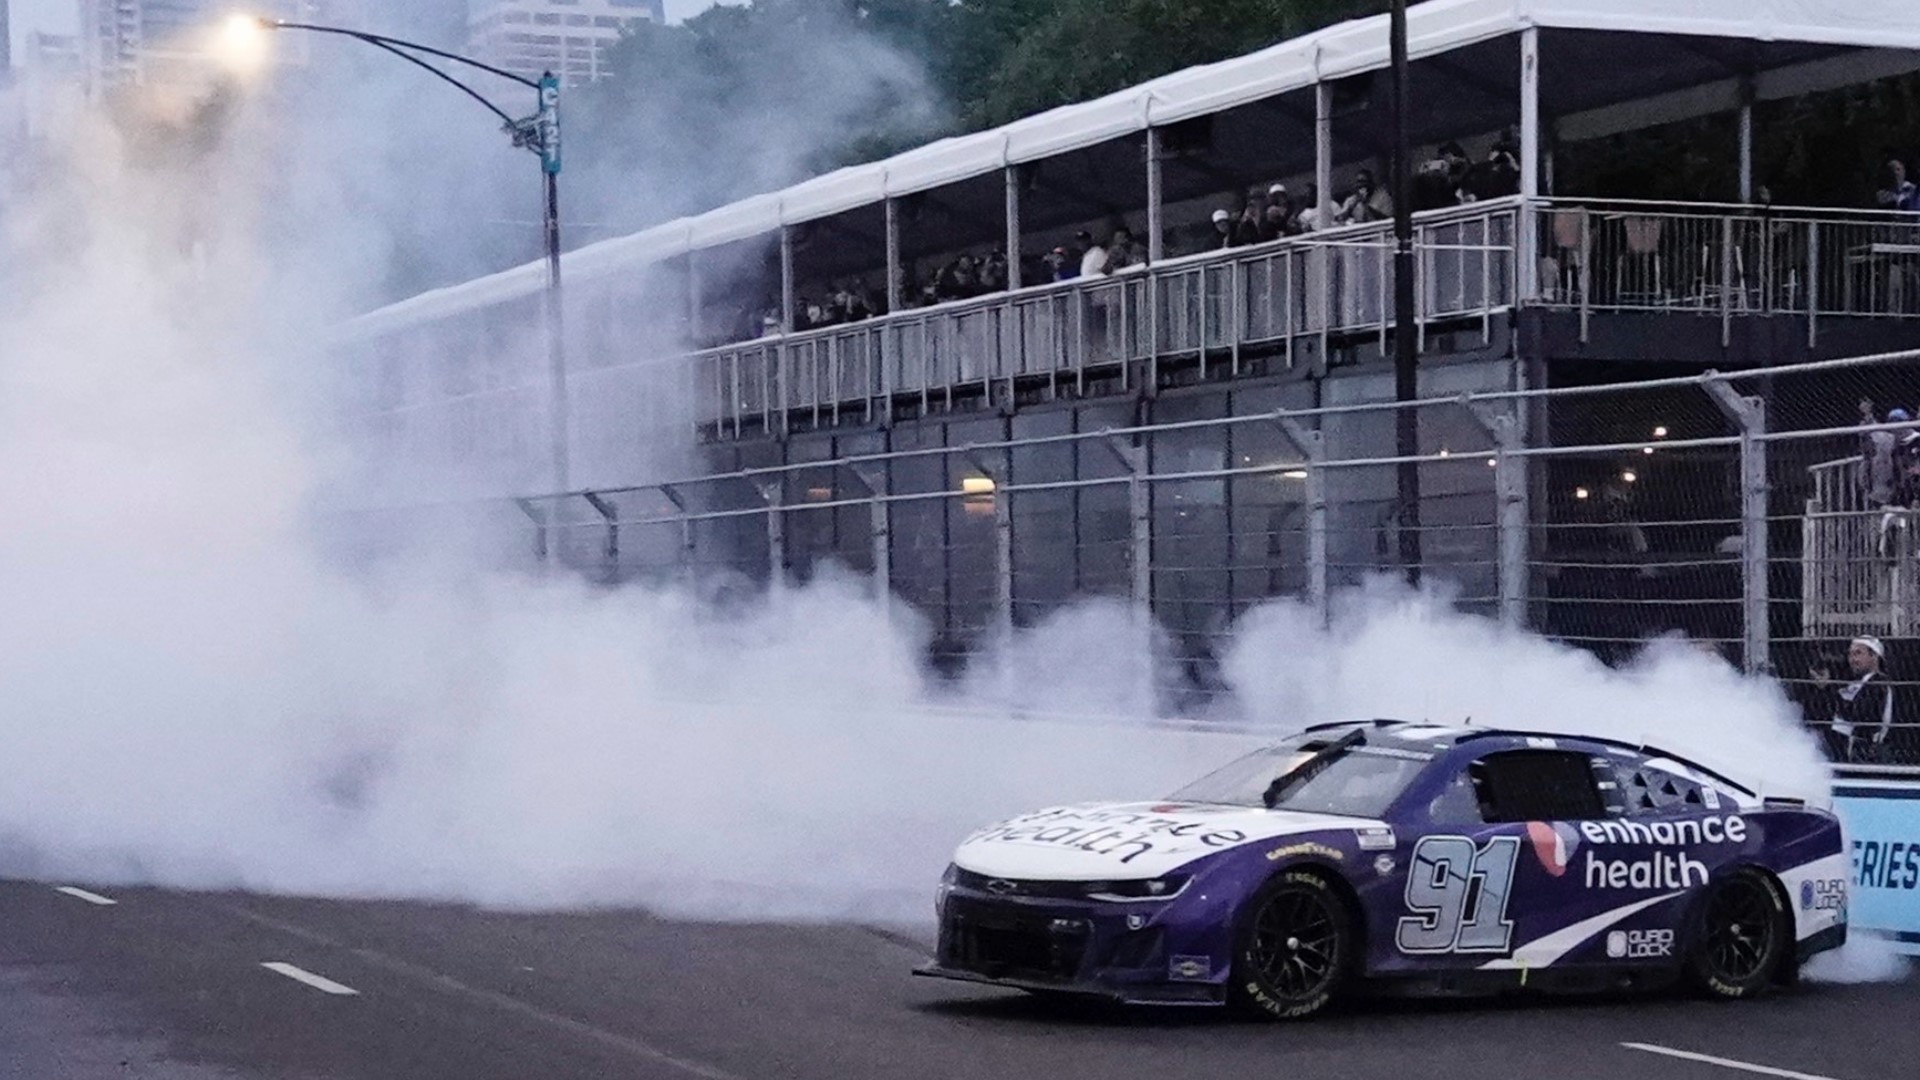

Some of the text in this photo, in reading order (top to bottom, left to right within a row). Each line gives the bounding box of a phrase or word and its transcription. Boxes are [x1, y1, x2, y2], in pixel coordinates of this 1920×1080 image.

[964, 824, 1153, 864] health
[1580, 814, 1747, 845] enhance
[1585, 850, 1709, 889] health
[1395, 835, 1521, 954] 91
[1628, 929, 1674, 944] QUAD
[1628, 943, 1672, 958] LOCK
